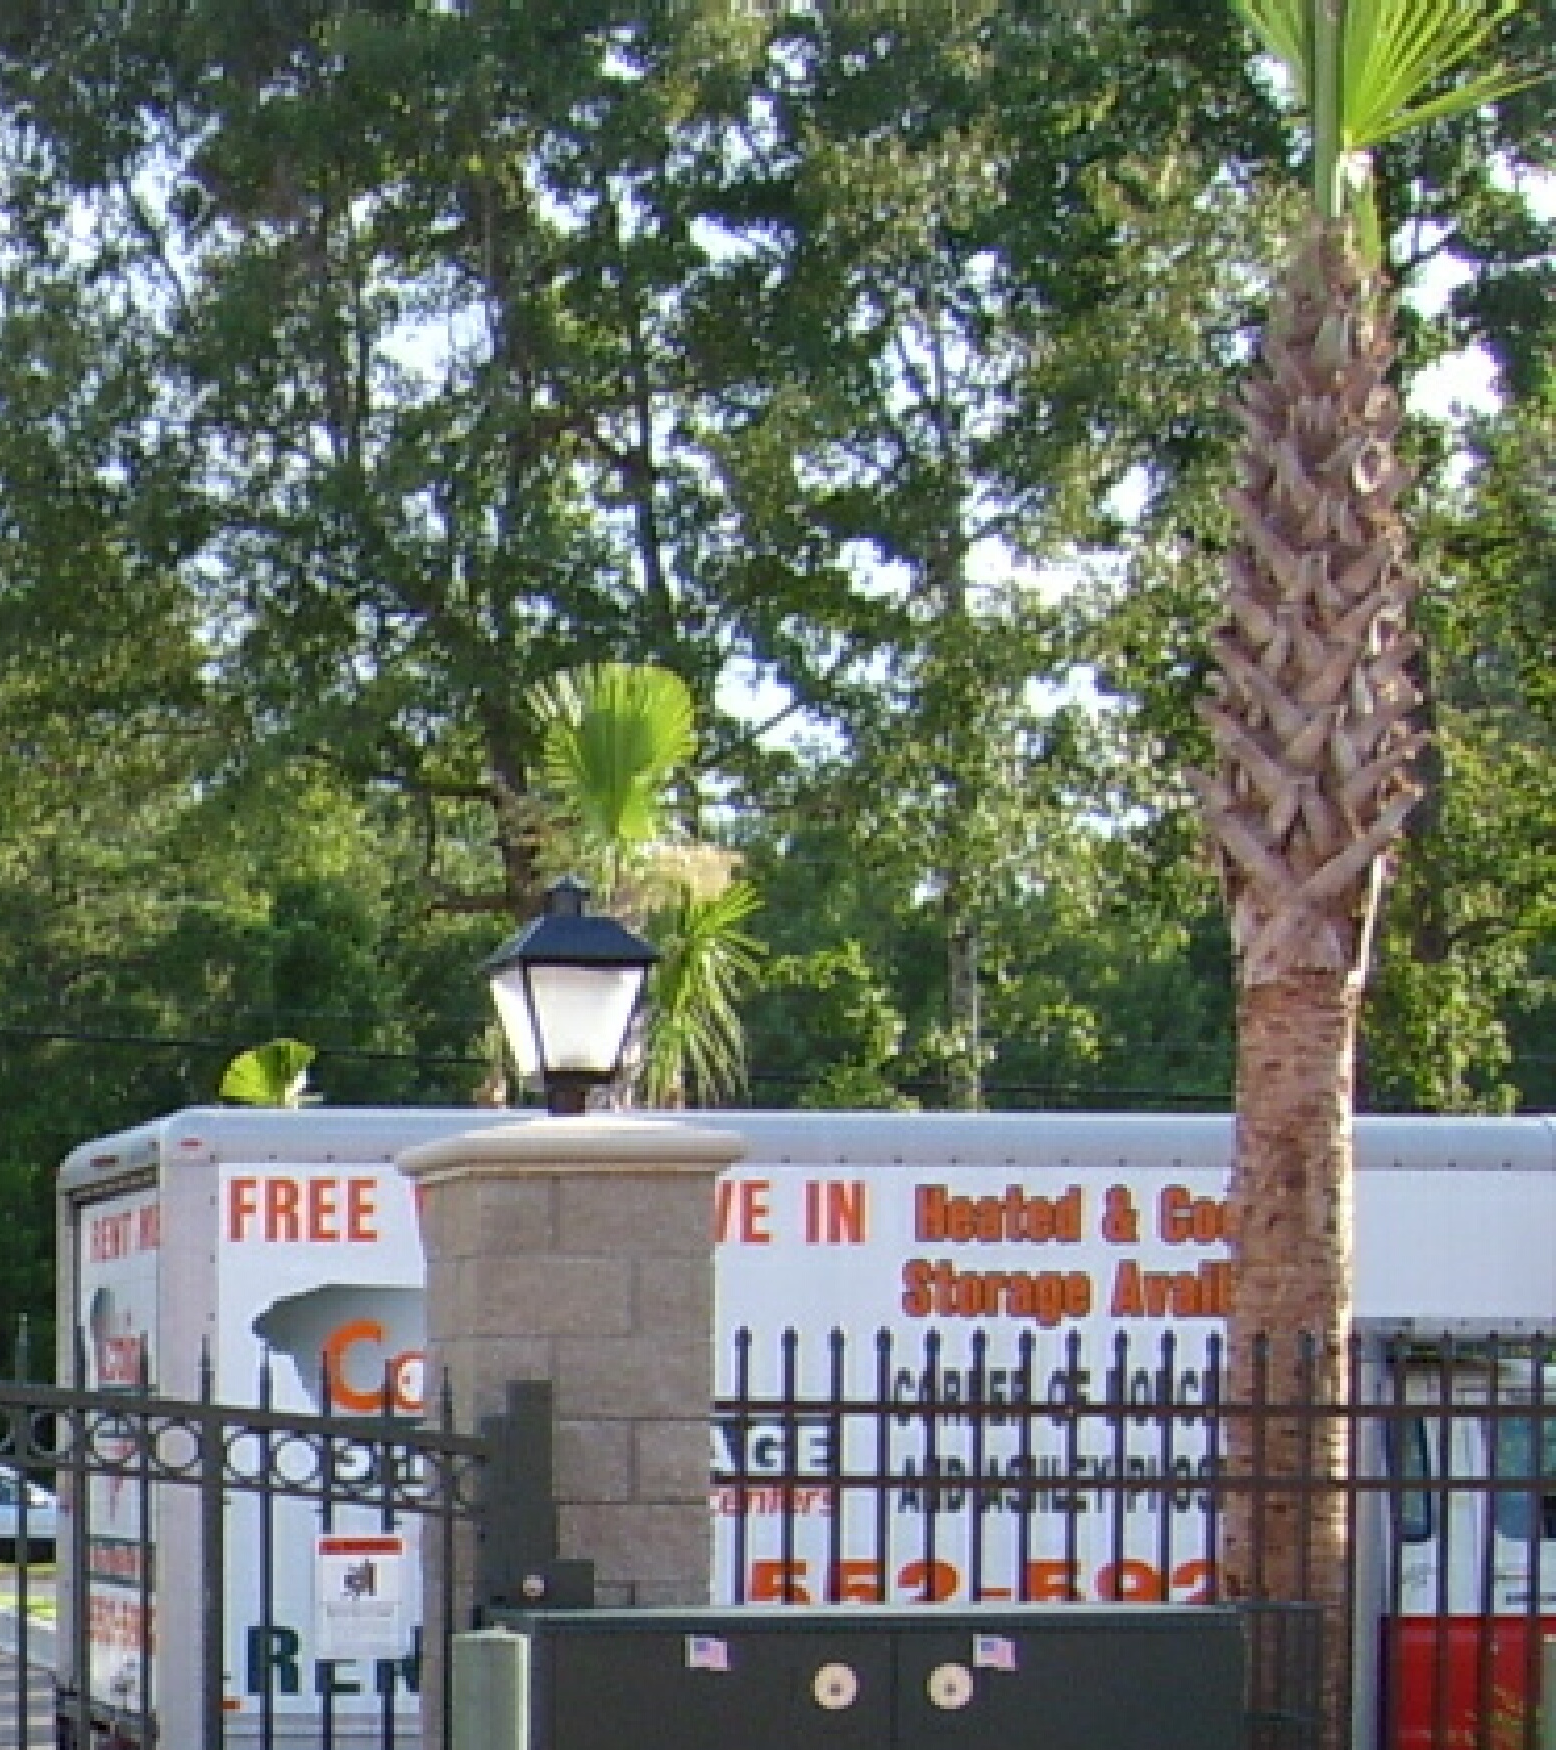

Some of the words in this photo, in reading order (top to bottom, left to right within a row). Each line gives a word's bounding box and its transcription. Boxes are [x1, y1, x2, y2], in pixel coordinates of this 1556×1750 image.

[227, 1177, 380, 1245] FREE
[804, 1178, 867, 1245] IN
[914, 1183, 1083, 1243] Heated
[1100, 1183, 1140, 1244] &
[901, 1258, 1093, 1330] Storage
[897, 1455, 966, 1514] AD
